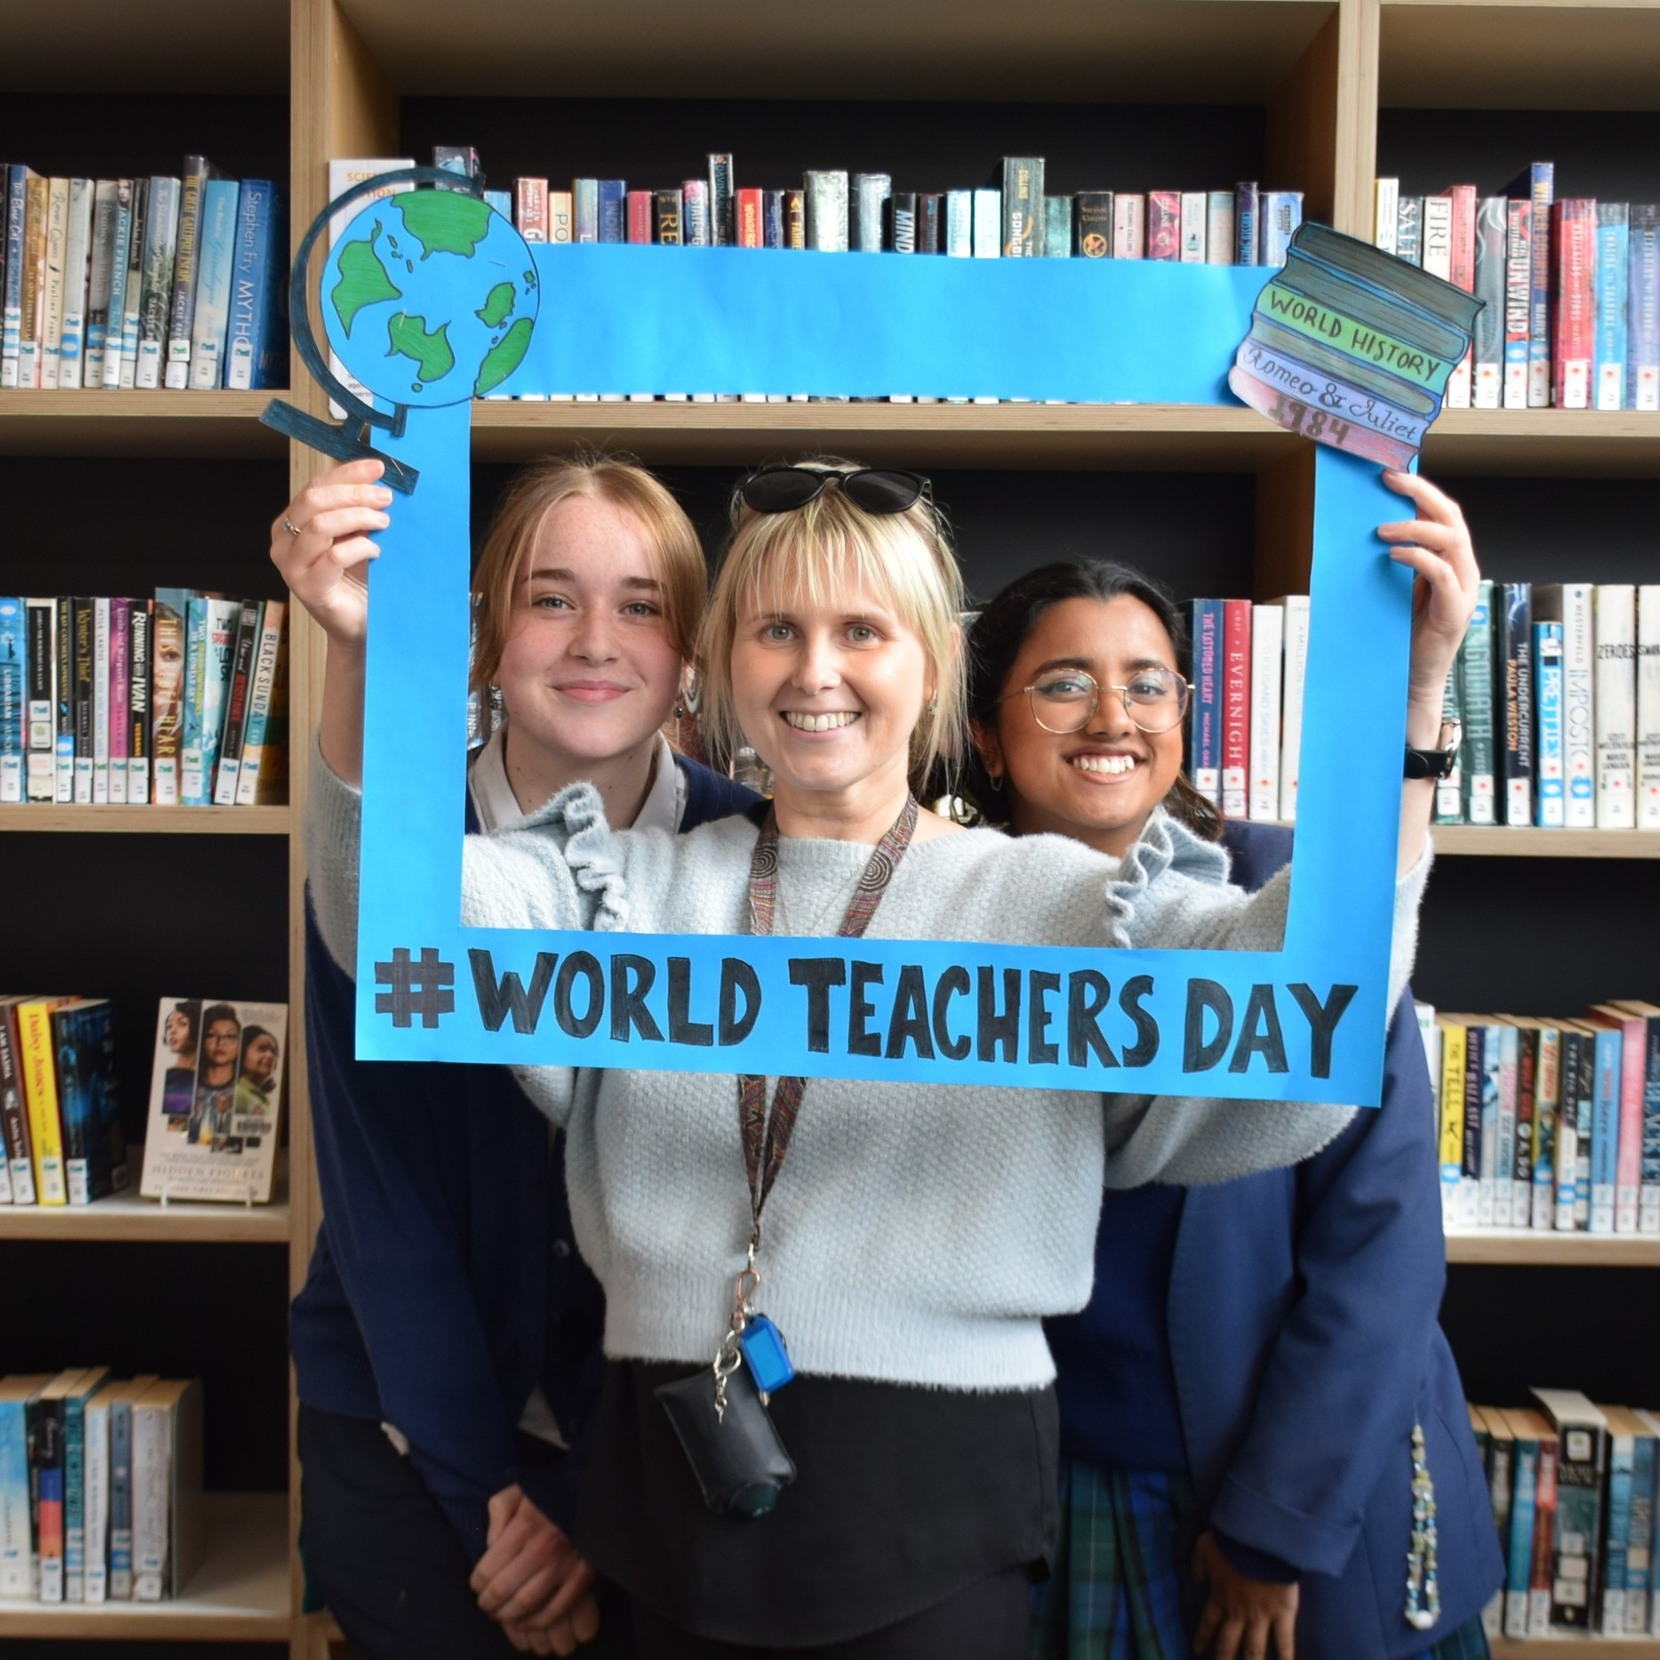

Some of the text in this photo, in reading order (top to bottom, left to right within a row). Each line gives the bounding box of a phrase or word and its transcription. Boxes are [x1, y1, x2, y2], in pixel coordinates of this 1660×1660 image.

[1018, 169, 1029, 200] COLLINS
[116, 206, 128, 245] JACKIE
[895, 209, 914, 254] MIND
[1397, 203, 1417, 261] SALT
[1428, 201, 1449, 257] FIRE
[112, 249, 126, 296] FRENCH
[233, 191, 263, 347] Stephen Fry MYTHO
[176, 290, 187, 320] JACKIE
[1507, 258, 1530, 334] UNWIND
[1269, 290, 1440, 382] WORLD HISTORY
[1243, 347, 1416, 440] Romeo & Juliet
[1267, 394, 1350, 445] 1984
[131, 611, 147, 663] RUNNING
[159, 618, 178, 653] THIS
[198, 619, 206, 641] TWO
[1203, 613, 1215, 630] THE
[1201, 631, 1215, 674] TATTOOED
[131, 676, 147, 713] IVAN
[251, 633, 278, 727] BLACK SUNDAY
[1201, 675, 1214, 705] HEART
[1464, 646, 1493, 740] GOLIATH
[1516, 641, 1529, 768] THE UNDERCURRENT
[1506, 658, 1518, 752] PAULA WESTON
[1568, 669, 1590, 758] IMPOSTO
[157, 715, 177, 756] HEAR
[1203, 712, 1211, 748] MICHAEL
[788, 957, 1160, 1068] TEACHERS
[1183, 978, 1359, 1079] DAY
[1445, 1065, 1460, 1112] TELL
